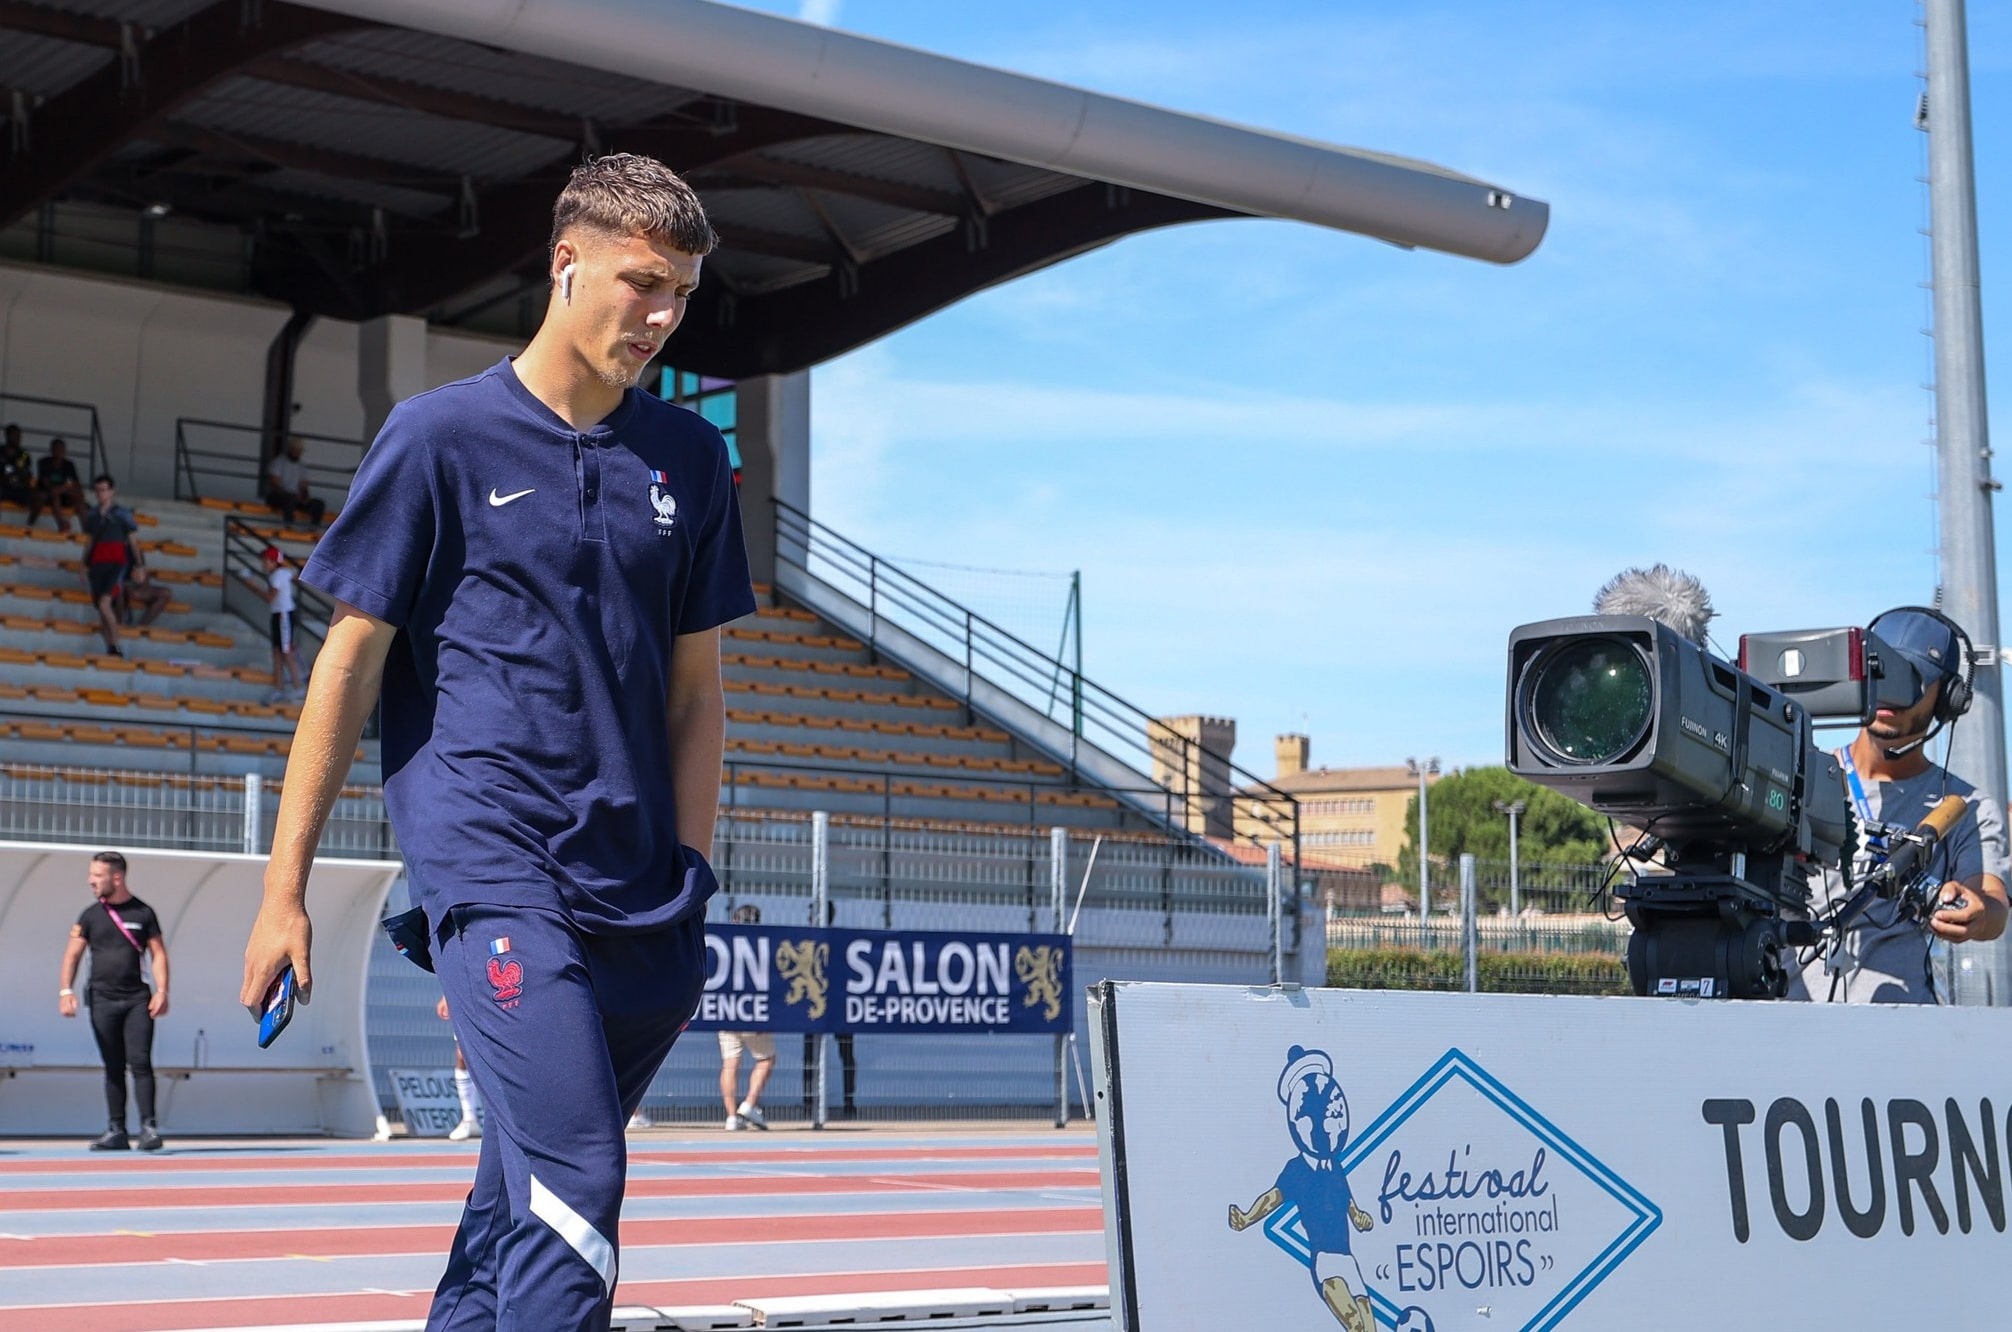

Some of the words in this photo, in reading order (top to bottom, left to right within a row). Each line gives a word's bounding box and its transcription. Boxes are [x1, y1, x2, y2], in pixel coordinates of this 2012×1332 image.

[1714, 732, 1728, 748] 4K
[704, 934, 770, 992] ON
[846, 939, 1010, 996] SALON
[846, 996, 1010, 1024] DE-PROVENCE
[398, 1077, 460, 1099] PELOUS
[1378, 1144, 1549, 1225] festival
[1702, 1096, 2012, 1244] TOURN
[1414, 1193, 1559, 1237] international
